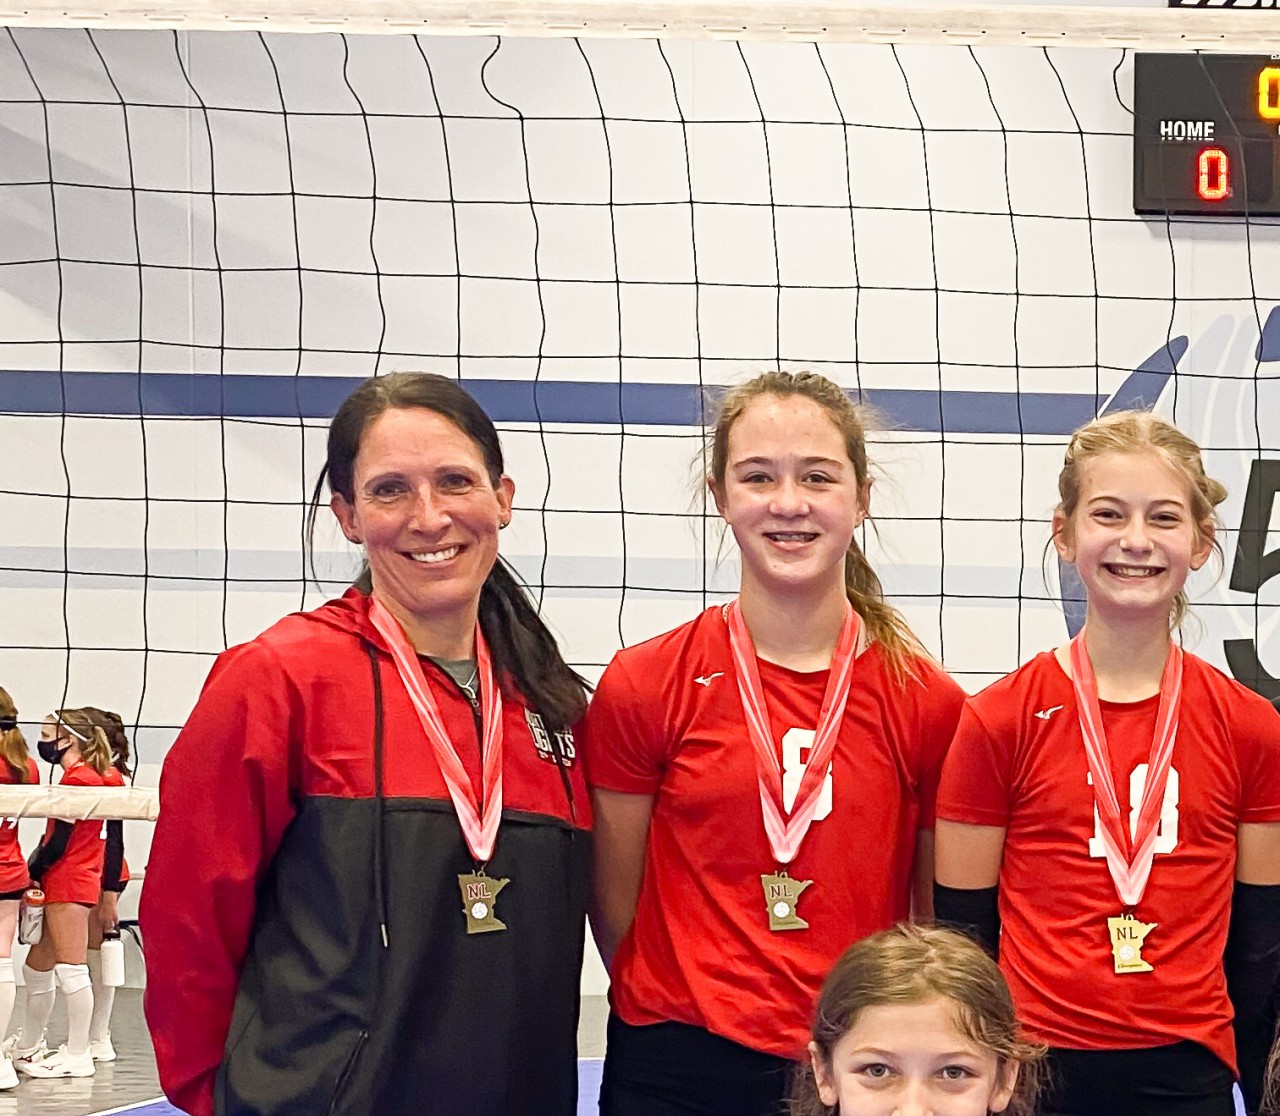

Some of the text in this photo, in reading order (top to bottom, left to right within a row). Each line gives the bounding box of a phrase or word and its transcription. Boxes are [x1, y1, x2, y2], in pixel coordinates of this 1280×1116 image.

[1160, 121, 1215, 141] HOME
[1199, 149, 1229, 200] 0
[782, 727, 833, 821] 8
[467, 882, 491, 900] NL
[770, 884, 793, 899] NL
[1116, 926, 1139, 941] NL
